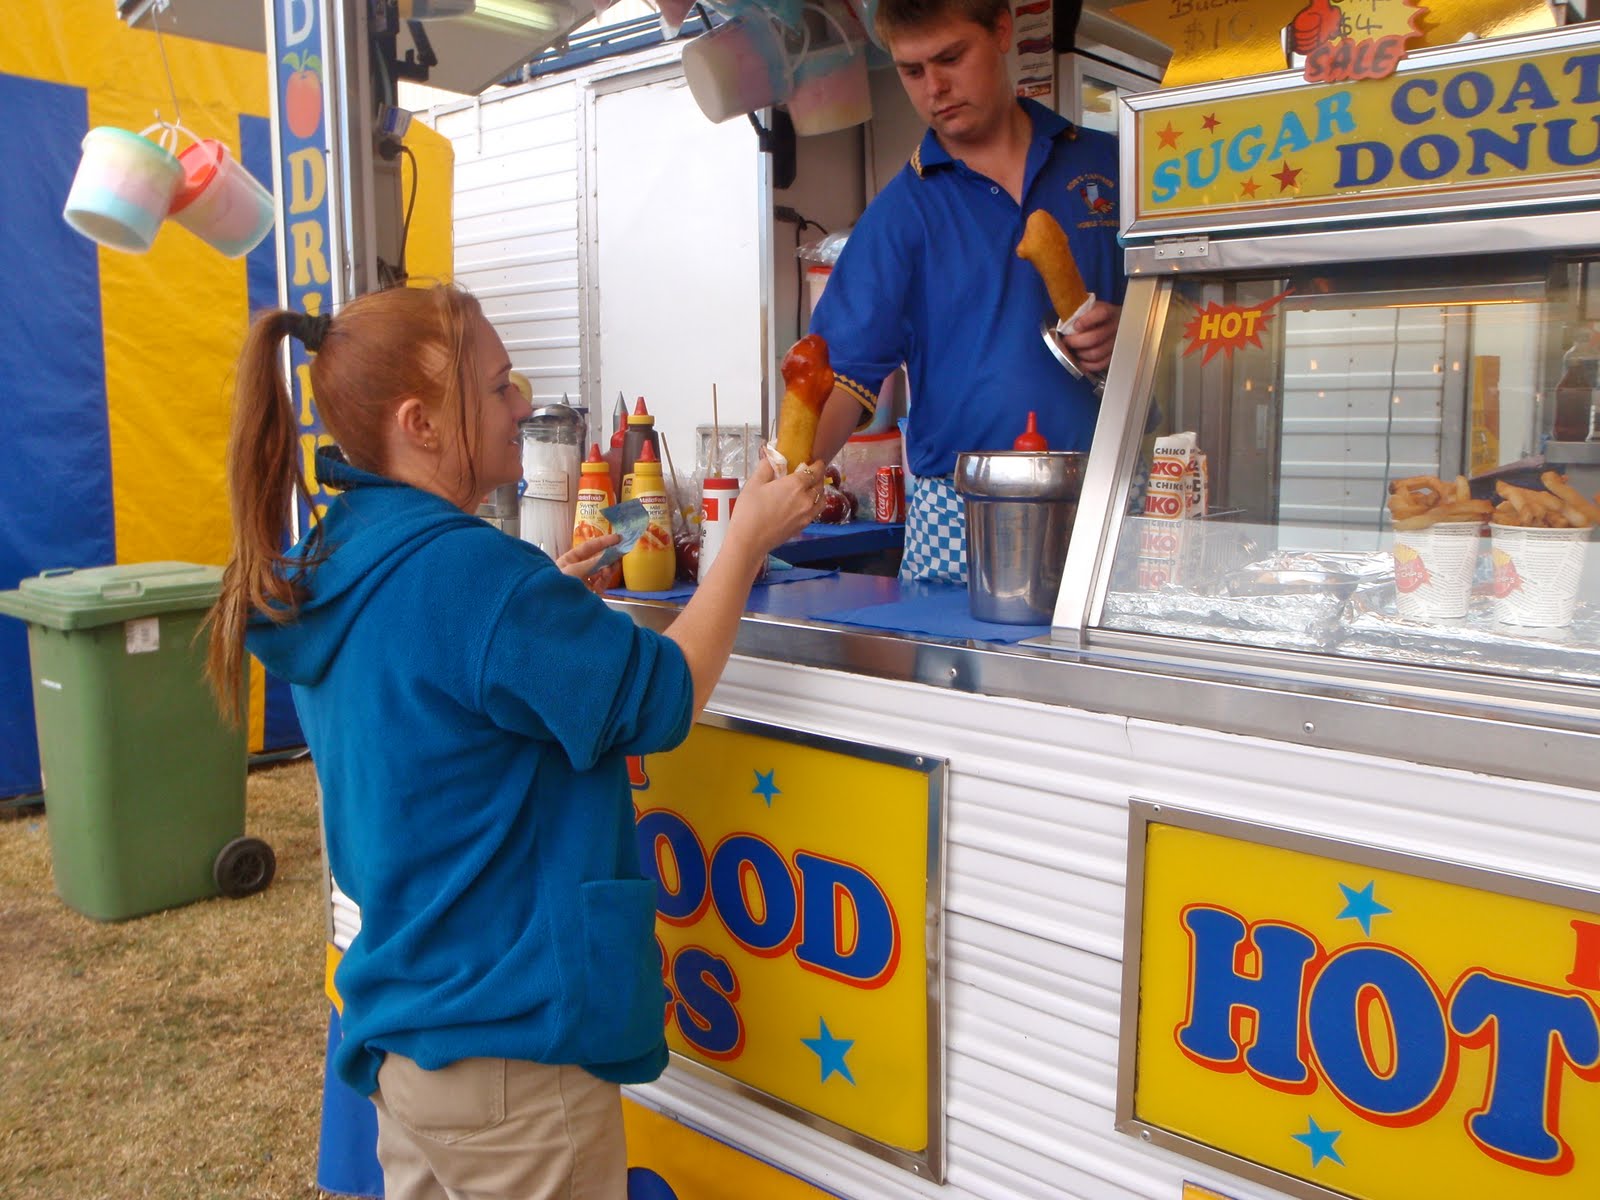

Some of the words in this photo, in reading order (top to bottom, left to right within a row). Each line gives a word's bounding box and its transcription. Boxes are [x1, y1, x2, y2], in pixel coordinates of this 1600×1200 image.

[1309, 39, 1398, 76] SALE
[1152, 91, 1357, 204] SUGAR
[1391, 54, 1600, 125] COAT
[1333, 115, 1600, 188] DONU
[1199, 310, 1261, 340] HOT
[1155, 447, 1186, 456] CHIKO
[635, 805, 901, 991] OOD
[662, 934, 746, 1062] S
[1173, 901, 1600, 1178] HOT
